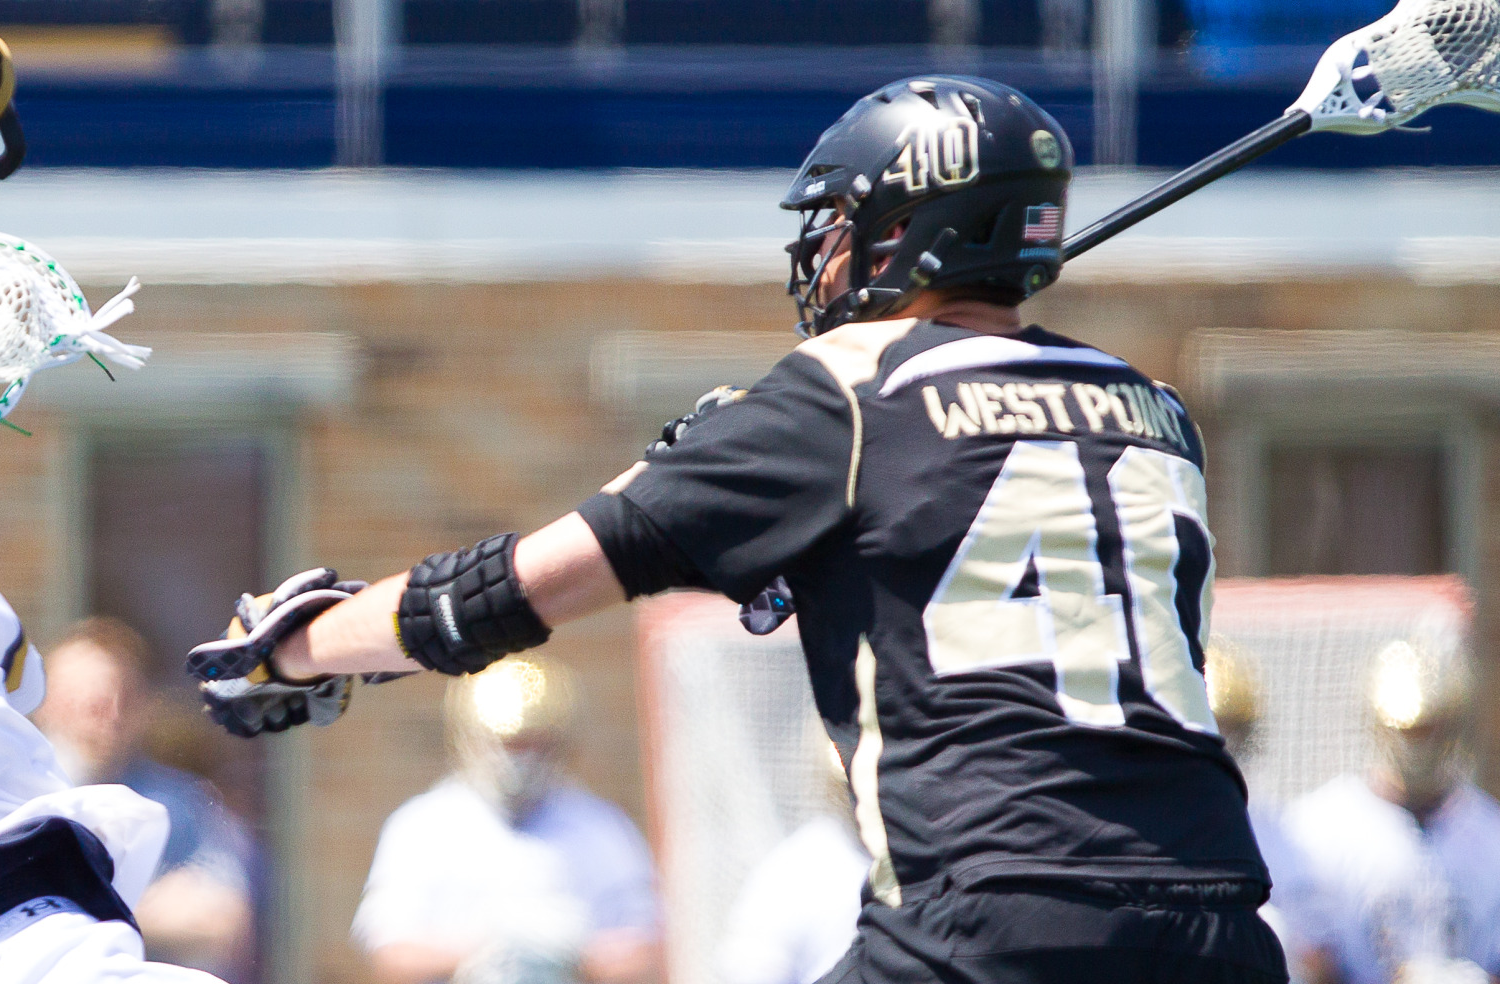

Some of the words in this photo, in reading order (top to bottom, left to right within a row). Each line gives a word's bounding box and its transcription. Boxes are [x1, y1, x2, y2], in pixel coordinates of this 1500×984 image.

[882, 116, 979, 192] 40
[921, 376, 1075, 439] WEST
[1070, 376, 1190, 451] POINT
[921, 439, 1220, 736] 40
